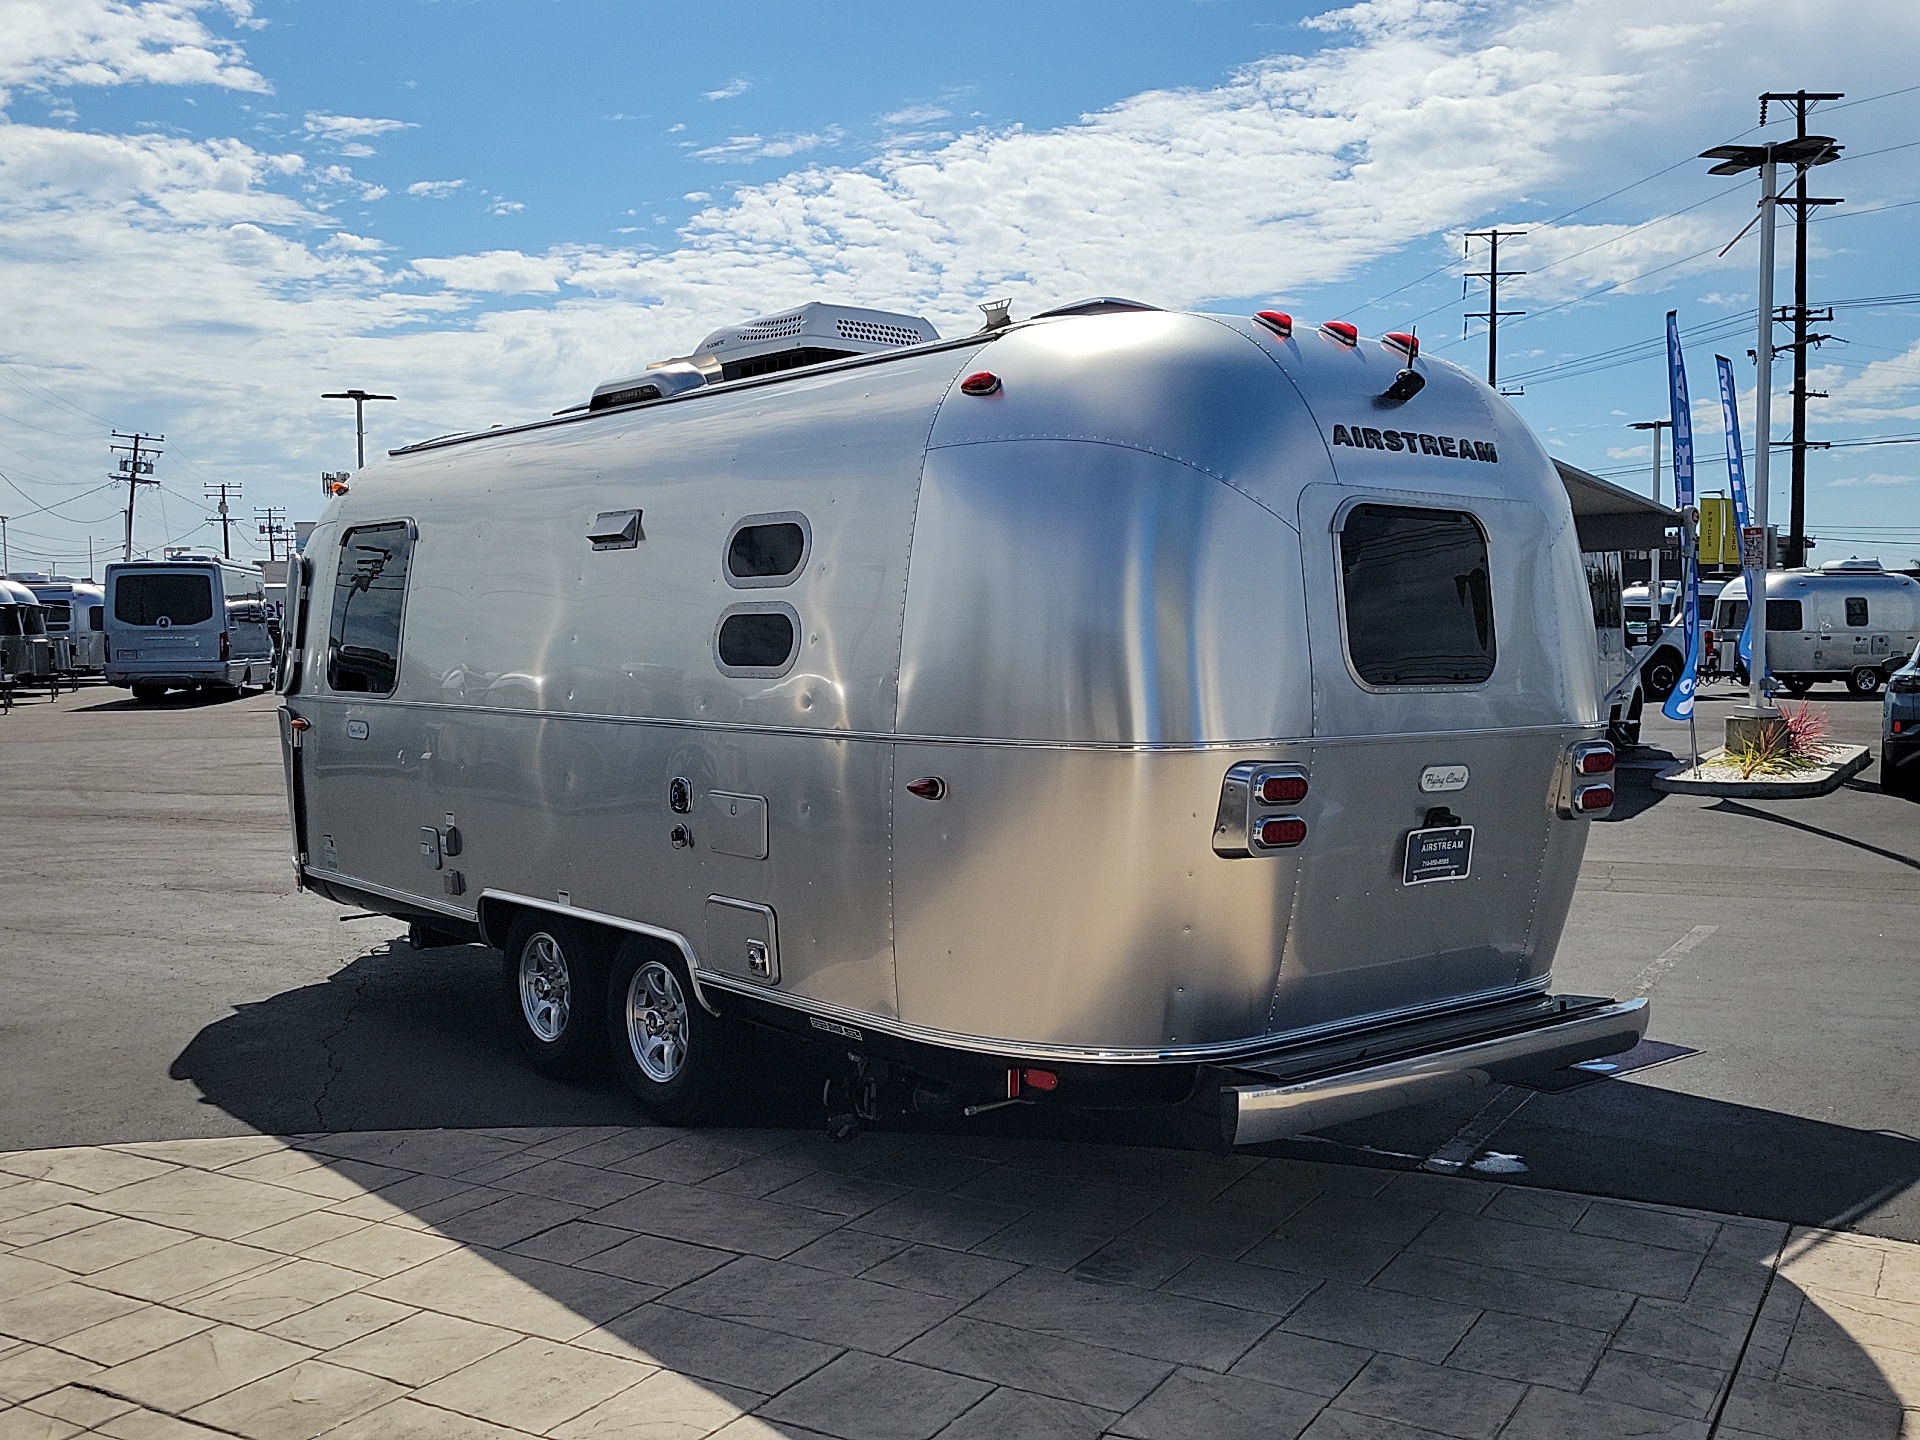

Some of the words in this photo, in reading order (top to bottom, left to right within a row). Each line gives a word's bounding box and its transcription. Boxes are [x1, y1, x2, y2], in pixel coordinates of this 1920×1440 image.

[1333, 424, 1498, 463] AIRSTREAM
[1425, 773, 1445, 789] Flying
[1445, 771, 1466, 784] Cloud
[1420, 840, 1464, 853] AIRSTREAM
